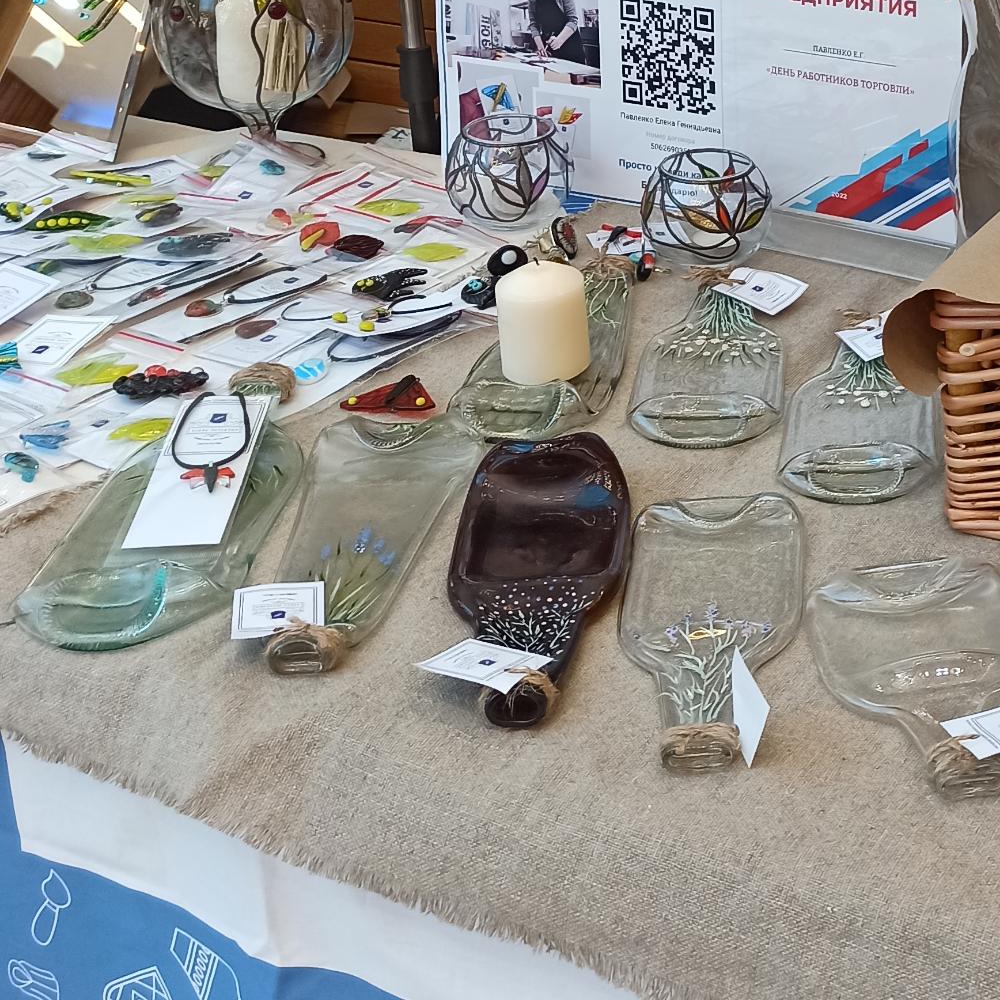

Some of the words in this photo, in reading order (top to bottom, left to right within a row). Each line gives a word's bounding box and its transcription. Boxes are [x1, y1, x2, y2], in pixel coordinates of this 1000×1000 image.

[812, 44, 852, 57] ПАВЛЕНКО
[766, 65, 796, 78] «ДЕНЬ
[797, 69, 859, 87] РАБОТНИКОВ
[860, 79, 915, 95] ТОРГОВЛИ»
[620, 111, 654, 124] Павленко
[655, 117, 676, 127] Елена
[676, 120, 721, 135] Геннадьевна
[618, 158, 652, 171] Просто
